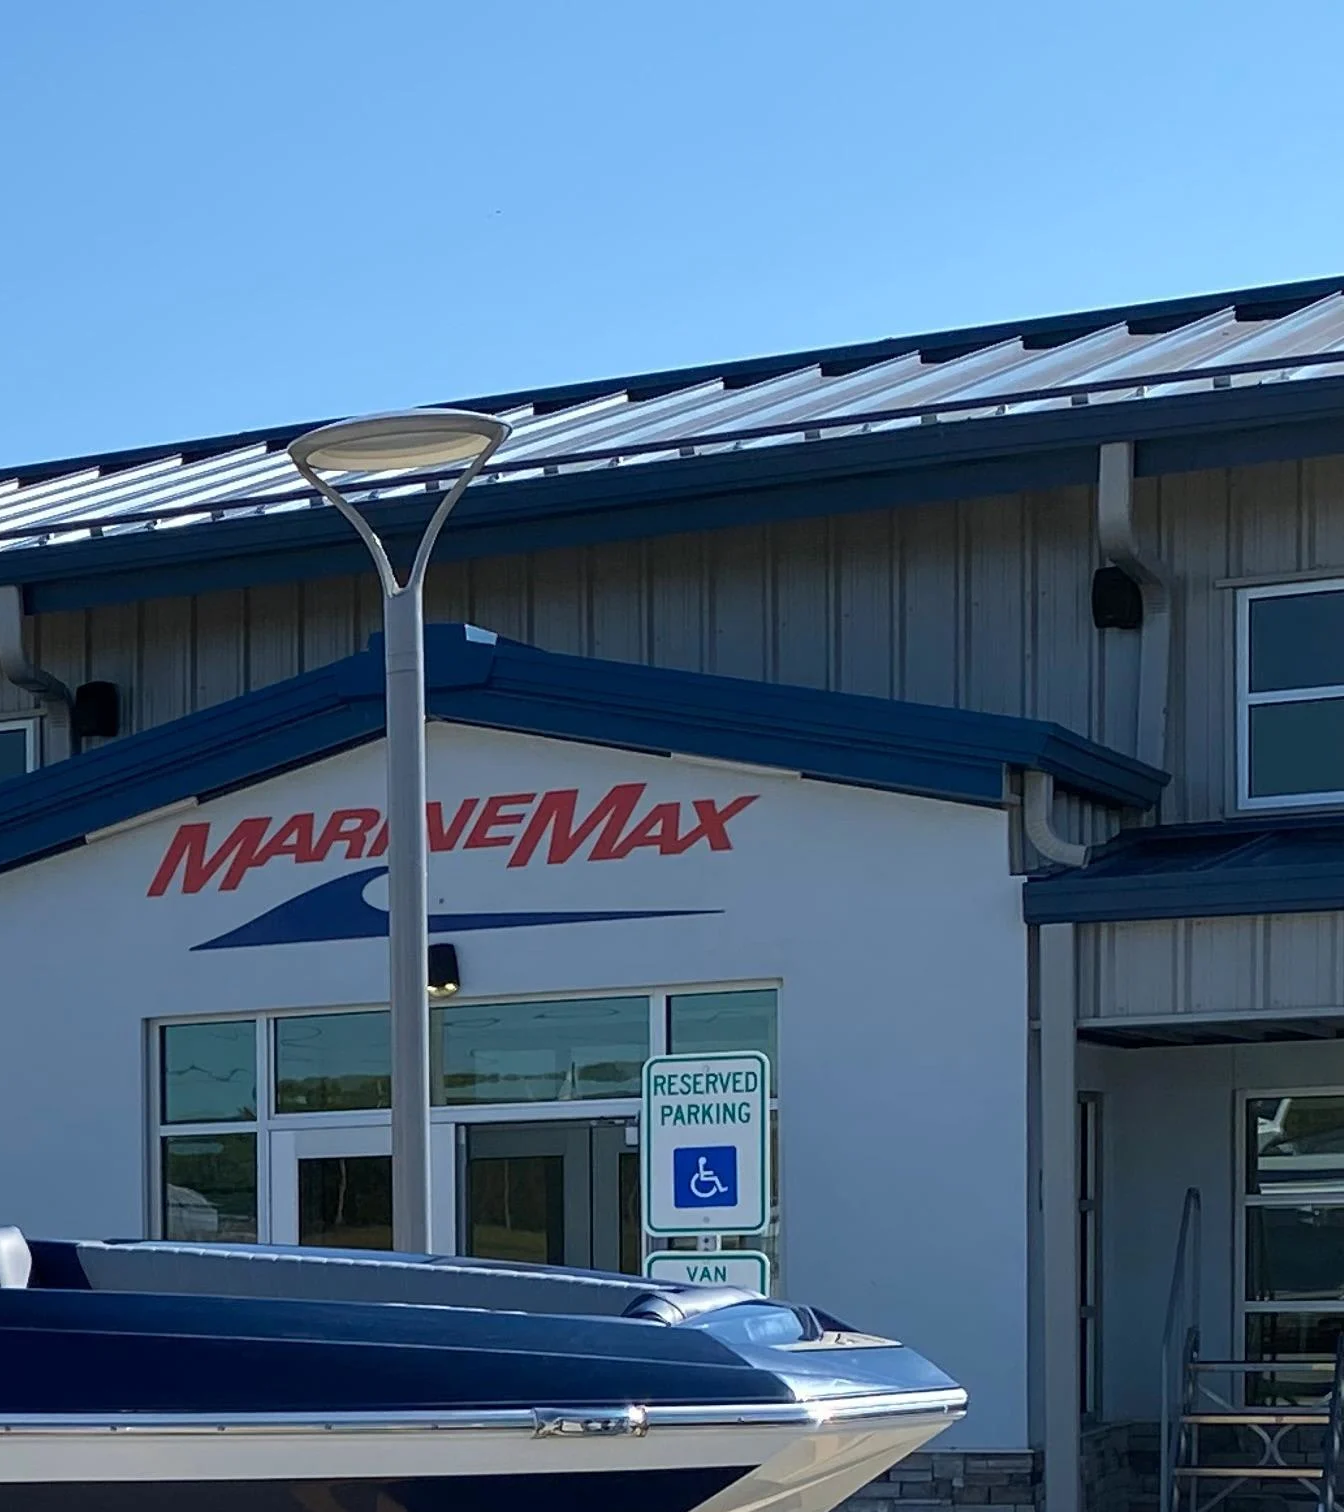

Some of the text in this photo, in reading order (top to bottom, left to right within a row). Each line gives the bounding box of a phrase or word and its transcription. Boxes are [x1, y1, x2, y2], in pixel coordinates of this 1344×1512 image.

[653, 1071, 758, 1097] RESERVED
[661, 1102, 751, 1126] PARKING
[686, 1266, 727, 1282] VAN
